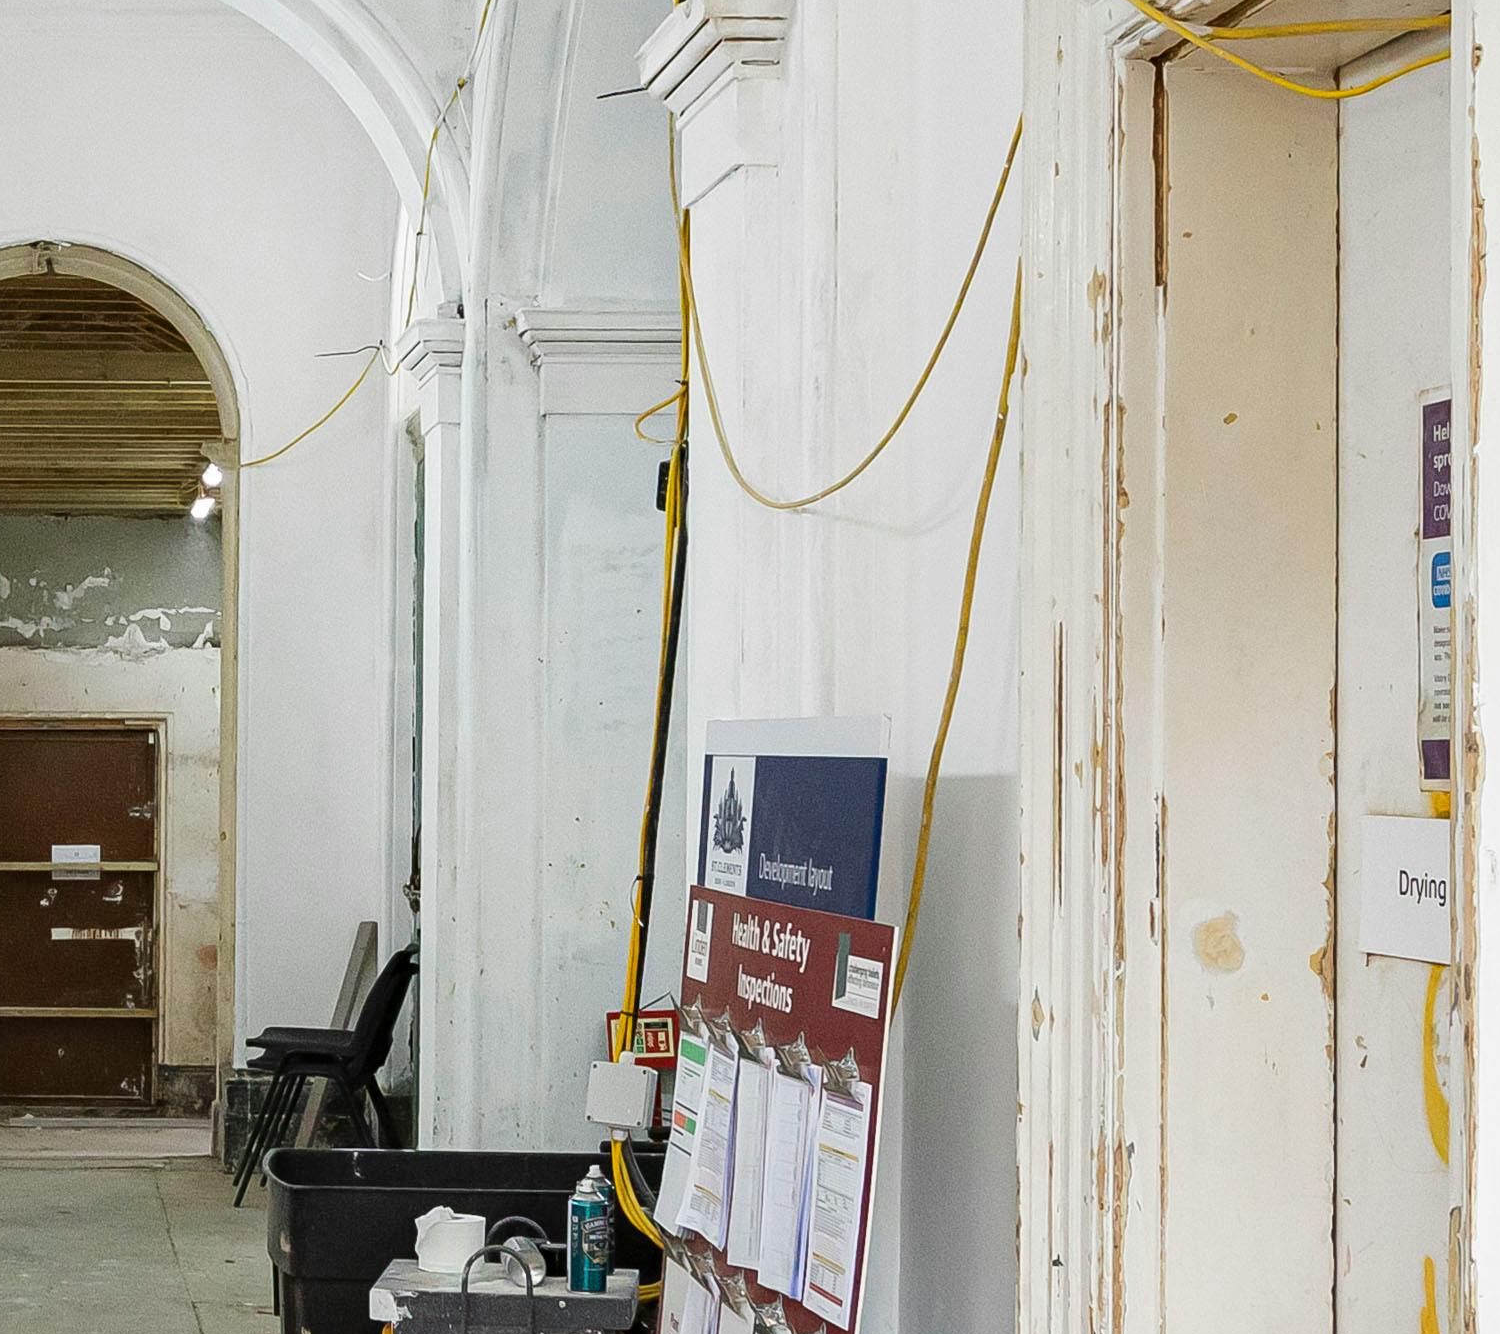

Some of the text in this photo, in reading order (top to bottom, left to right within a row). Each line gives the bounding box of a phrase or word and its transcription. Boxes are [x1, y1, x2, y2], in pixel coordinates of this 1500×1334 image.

[758, 853, 833, 896] Development layout
[1399, 870, 1447, 907] Drying
[731, 912, 811, 974] Health & Safety
[737, 963, 793, 1014] Inspections
